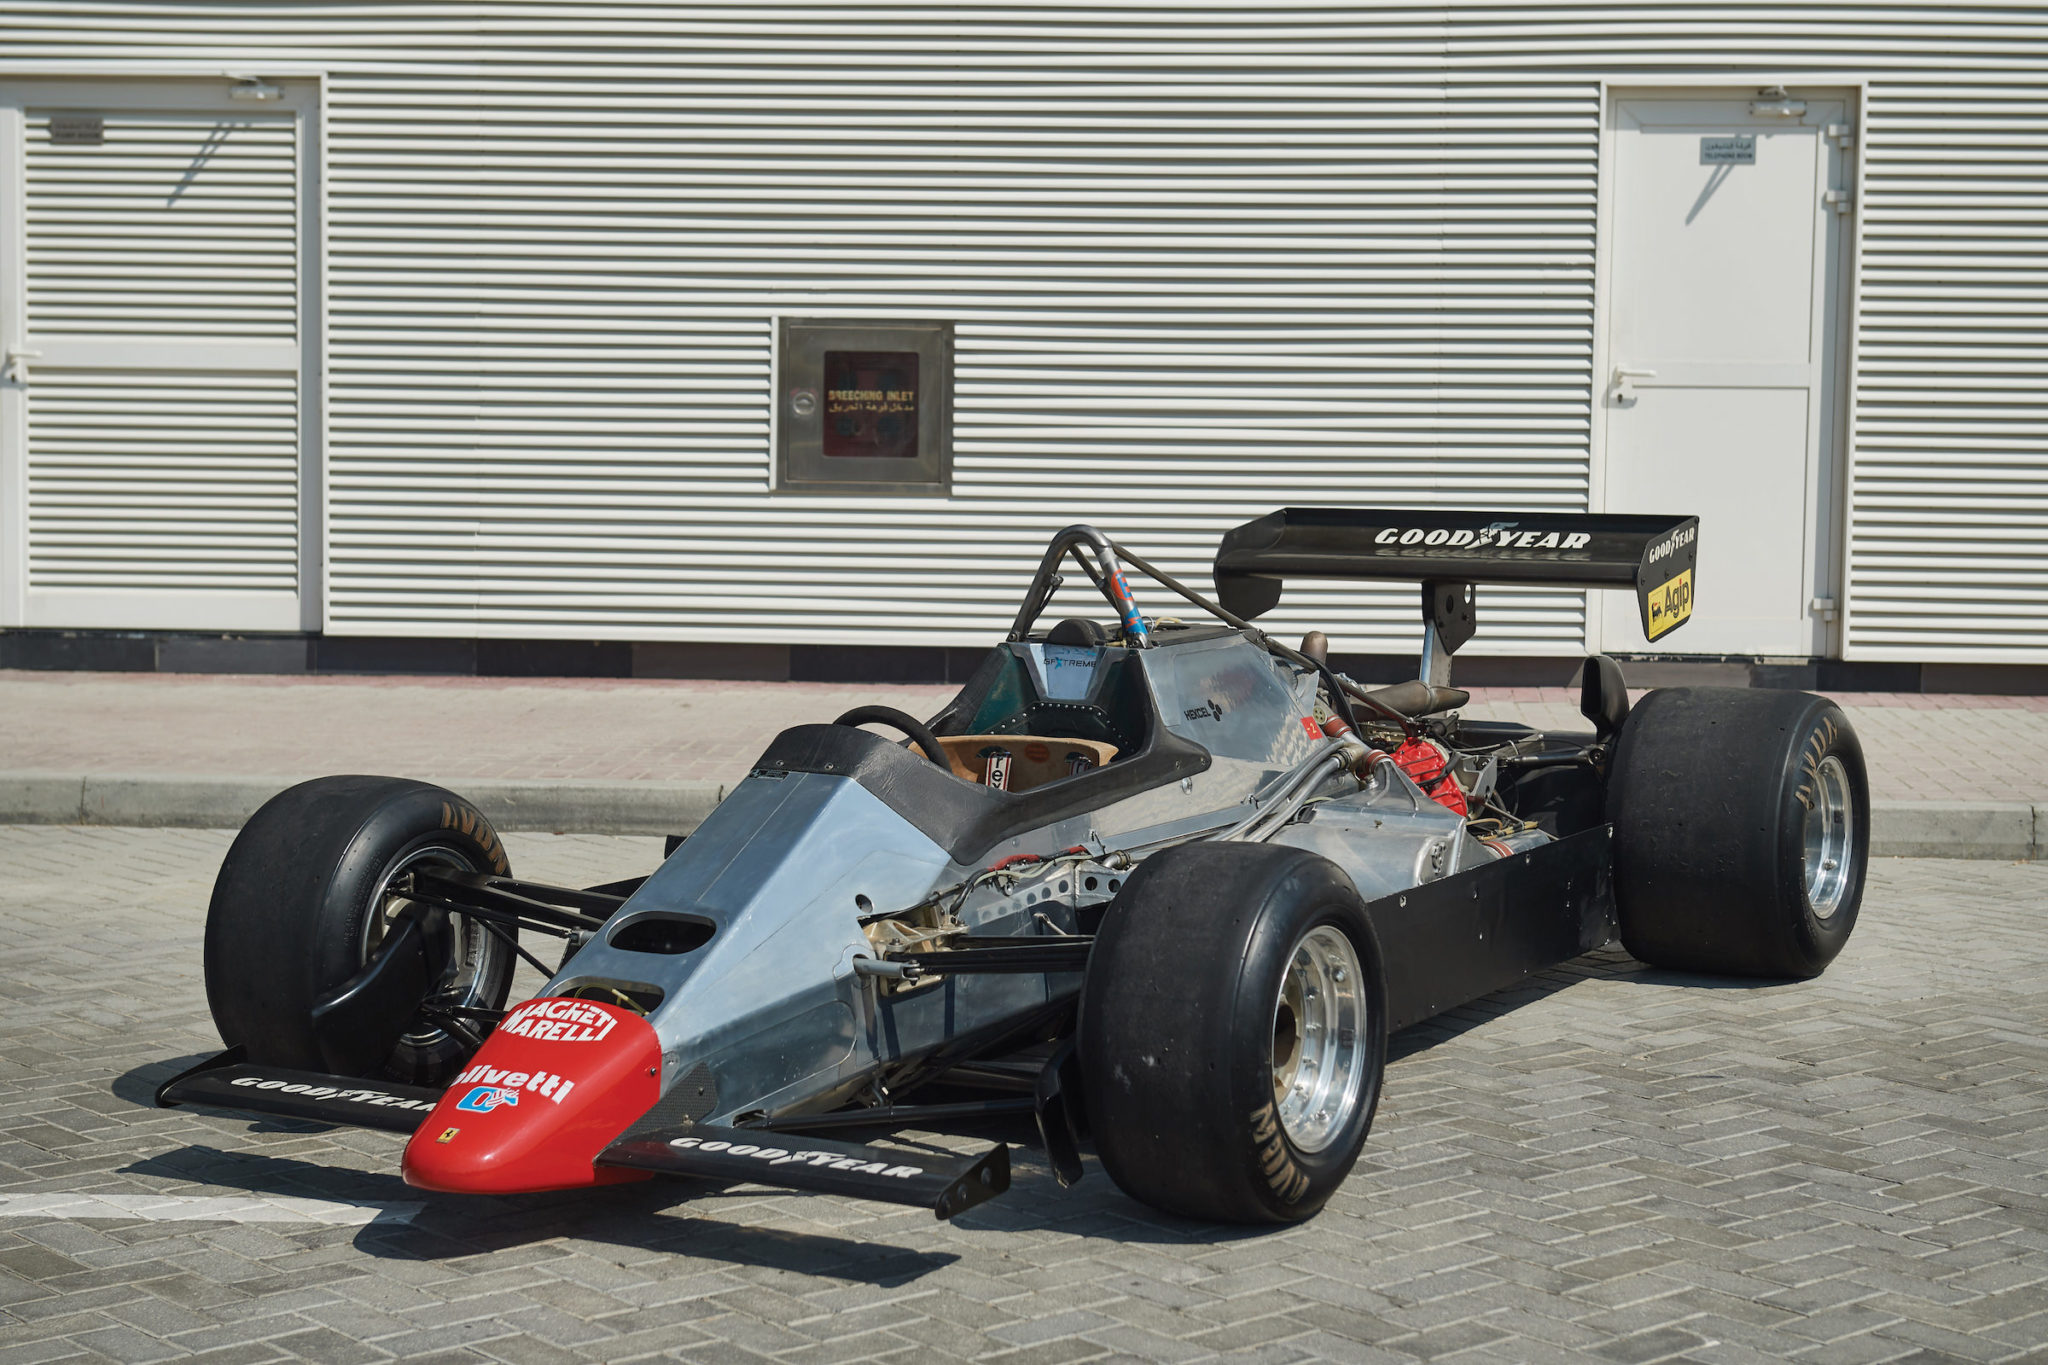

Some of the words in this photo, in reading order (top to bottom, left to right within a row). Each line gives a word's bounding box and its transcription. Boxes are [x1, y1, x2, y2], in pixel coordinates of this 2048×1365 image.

[828, 389, 883, 401] BREECHING
[886, 390, 914, 401] INLET
[1375, 525, 1592, 550] GOODYEAR
[1663, 578, 1690, 618] Agip
[1184, 706, 1212, 720] HEXCEL
[504, 1000, 618, 1029] MAGNETI
[500, 1018, 612, 1042] MARELLI
[669, 1137, 924, 1179] GOODYEAR
